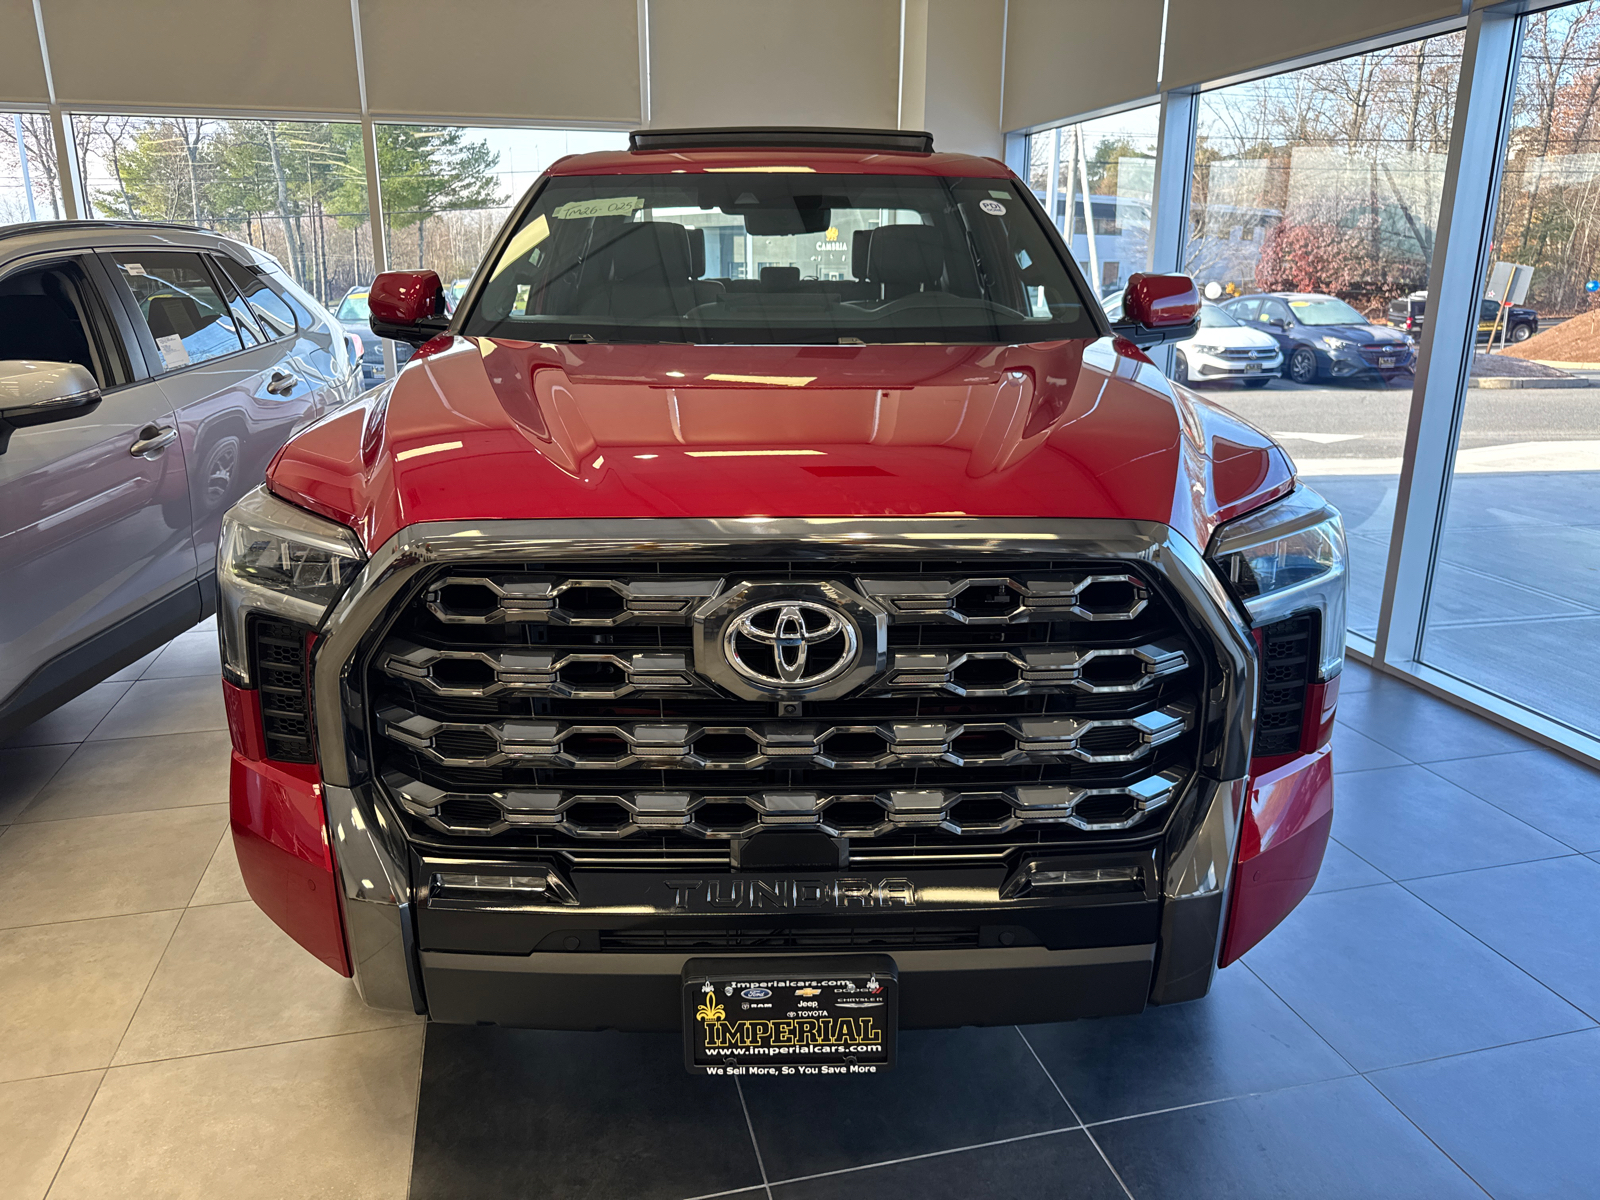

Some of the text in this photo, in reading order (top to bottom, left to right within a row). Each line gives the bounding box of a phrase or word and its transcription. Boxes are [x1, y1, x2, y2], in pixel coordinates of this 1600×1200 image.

[816, 241, 848, 251] CAMBRIA
[664, 877, 916, 908] TUNDRA
[731, 980, 850, 988] Imperialcars.com
[797, 1001, 818, 1009] Jeep
[705, 1018, 881, 1046] IMPERIAL
[705, 1045, 882, 1056] www.imperialcars.com
[706, 1065, 877, 1076] We Sell More, So You Save More
